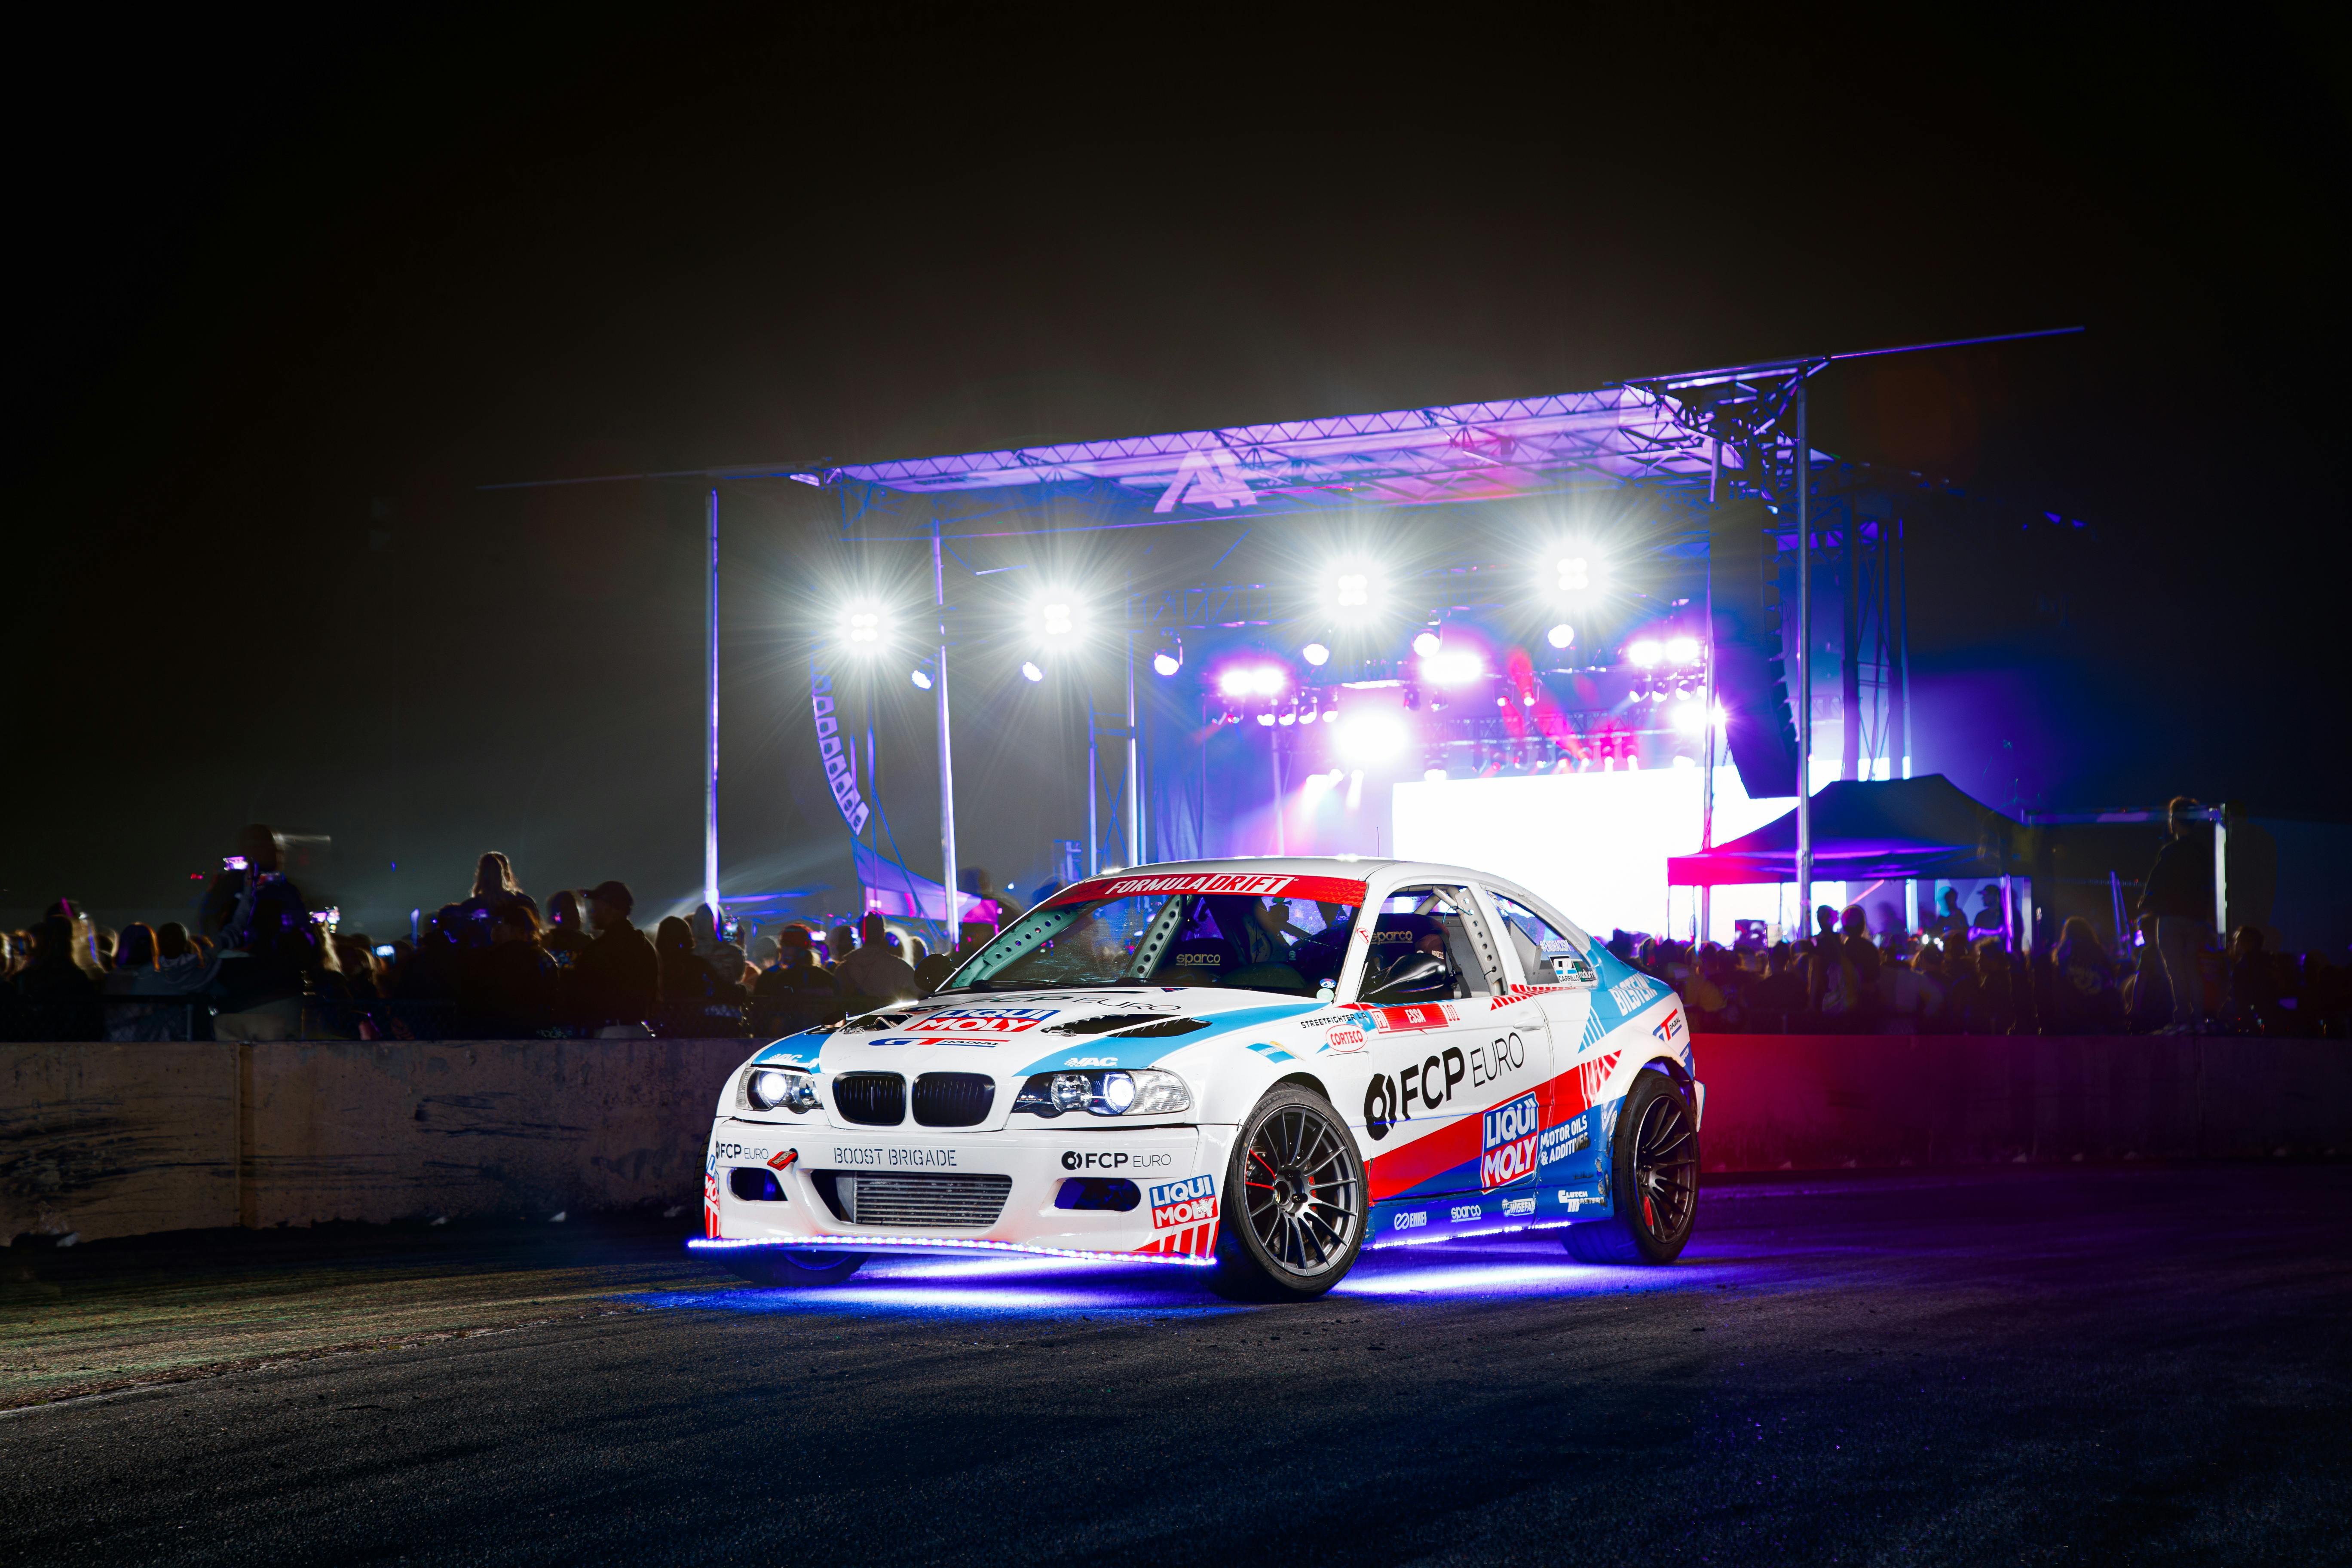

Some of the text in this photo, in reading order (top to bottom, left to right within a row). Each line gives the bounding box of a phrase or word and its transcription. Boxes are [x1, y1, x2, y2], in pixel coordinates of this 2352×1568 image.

[1176, 953, 1221, 966] sparco
[1072, 997, 1181, 1011] EURO
[932, 1009, 1055, 1020] LIQUI
[1301, 1014, 1357, 1029] STREETFIGHTER
[1404, 1008, 1427, 1024] ESSA
[1442, 1004, 1461, 1022] 101
[911, 1018, 1038, 1032] MOLY
[1669, 1016, 1681, 1031] RADIAL
[1330, 1030, 1363, 1046] CORTECO
[1400, 1032, 1524, 1120] FCP EURO
[1486, 1097, 1536, 1148] LIQUI
[1540, 1115, 1588, 1150] MOTOR OILS
[721, 1143, 769, 1160] FCP EURO
[834, 1147, 957, 1167] BOOST BRIGADE
[1540, 1151, 1548, 1166] &
[1085, 1152, 1171, 1169] FCP EURO
[1484, 1135, 1537, 1188] MOLY
[1152, 1176, 1213, 1207] LIQUI
[1558, 1190, 1588, 1204] CLUTCH
[1155, 1197, 1215, 1228] MOLY
[1451, 1204, 1482, 1222] sparco
[1510, 1200, 1535, 1214] WISEFAB
[1410, 1211, 1427, 1228] ENKEI
